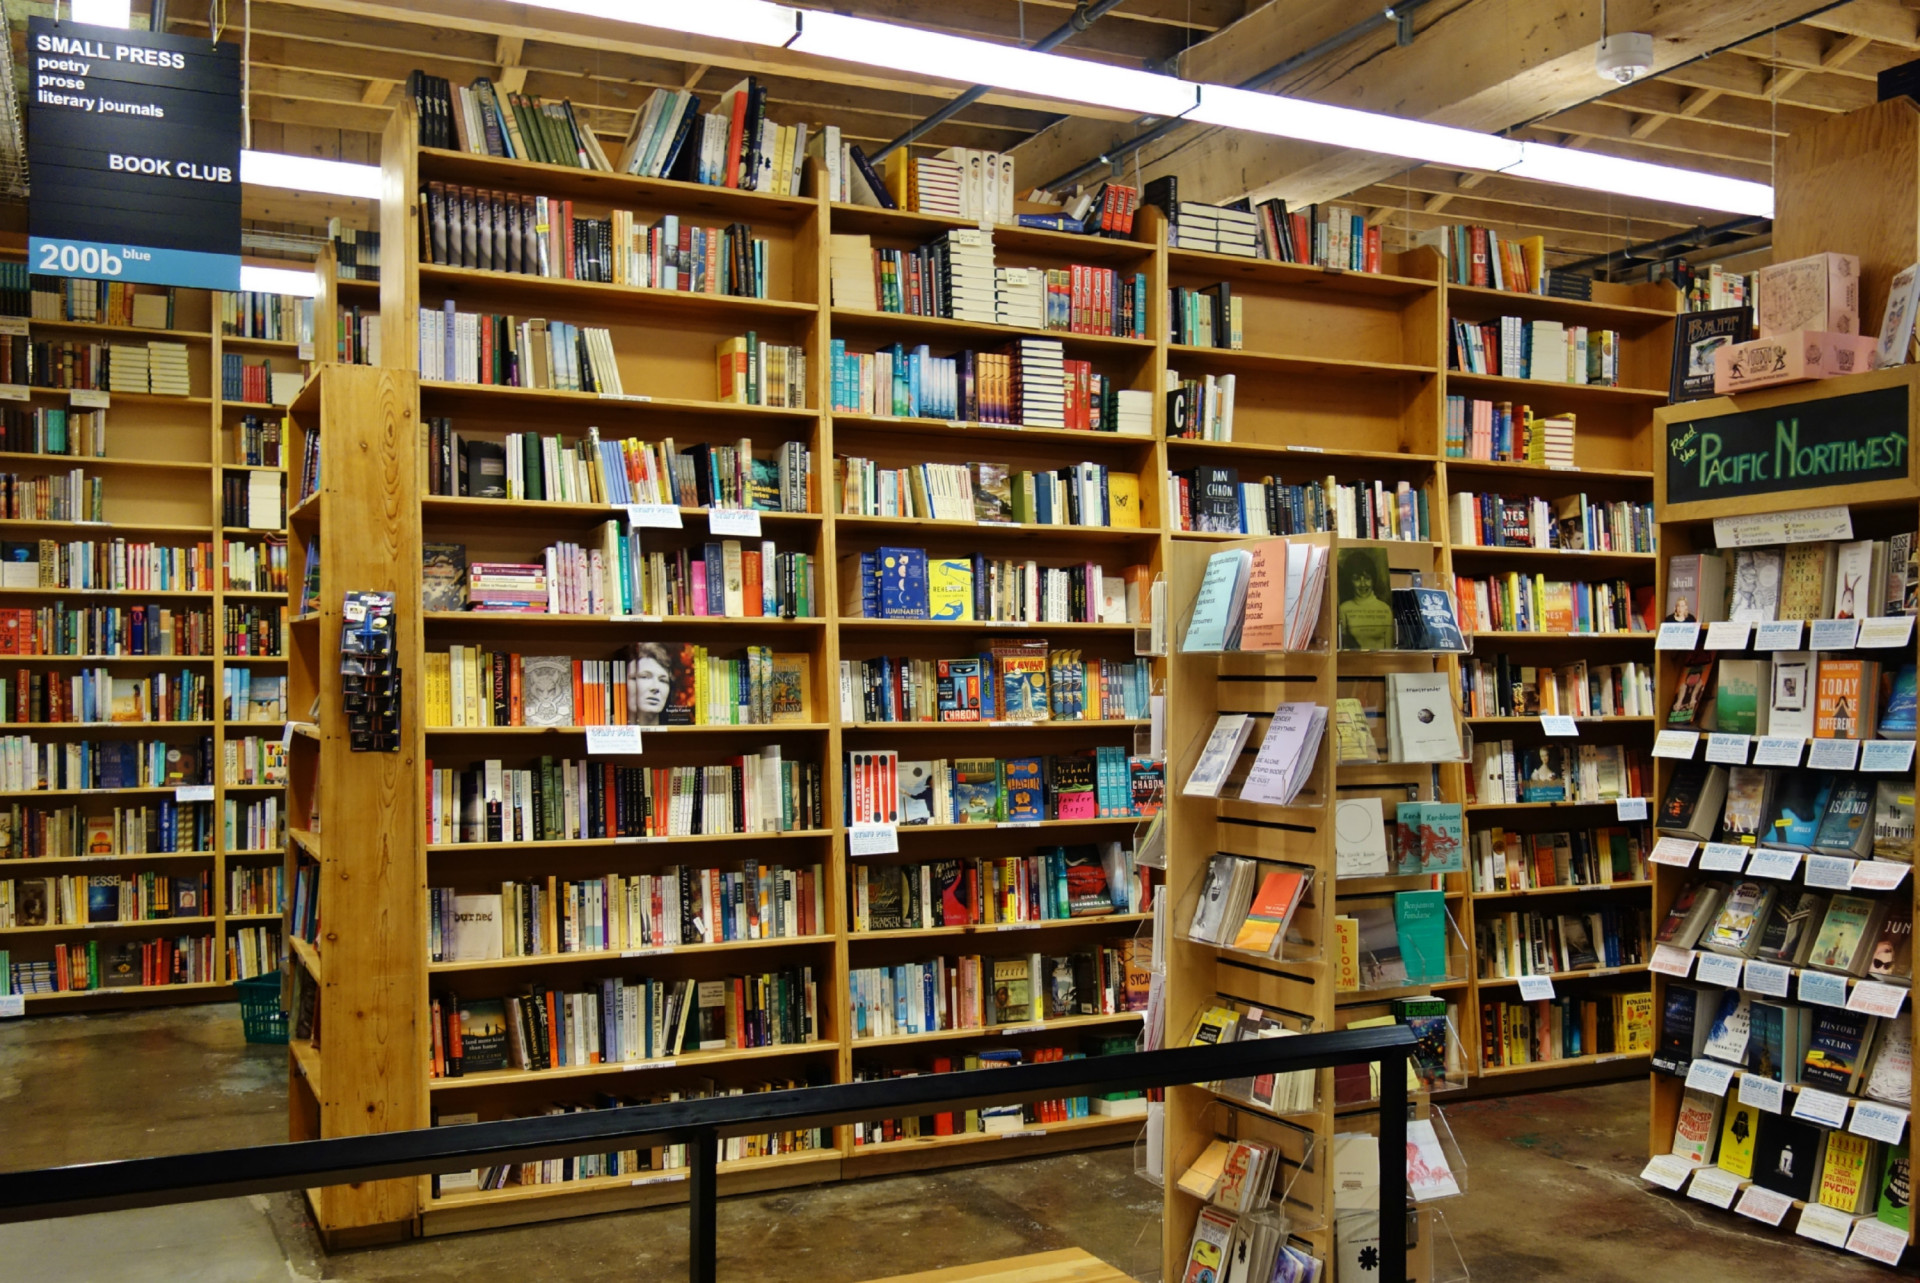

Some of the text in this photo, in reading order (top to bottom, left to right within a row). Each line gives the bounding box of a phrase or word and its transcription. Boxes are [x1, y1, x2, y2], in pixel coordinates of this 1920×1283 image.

[37, 35, 185, 69] SMALL PRESS
[38, 56, 90, 76] poetry
[38, 73, 85, 90] prose
[38, 90, 164, 118] literary journals
[109, 154, 232, 183] BOOK CLUB
[39, 244, 151, 275] 200b blue
[1173, 394, 1185, 429] C
[1670, 424, 1697, 456] Read
[1679, 447, 1698, 463] the
[1699, 418, 1908, 488] PACIFIC NORTHWEST
[1212, 470, 1228, 482] DAN
[1206, 483, 1233, 497] CHAON
[1213, 503, 1230, 515] ILL
[1892, 536, 1908, 548] ROSE
[1257, 570, 1266, 578] the
[1249, 580, 1270, 588] nternet
[1672, 576, 1693, 588] shrill
[1245, 612, 1264, 620] prozac
[1821, 679, 1858, 695] TODAY
[1820, 699, 1857, 711] WILL BE
[944, 710, 979, 720] CHABON
[1819, 718, 1857, 730] DIFFERENT
[1132, 780, 1164, 789] CHABON
[1062, 805, 1084, 814] Boys
[1829, 801, 1867, 814] ISLAND
[1889, 805, 1901, 819] The
[1426, 813, 1462, 822] Ker-bloom!
[1723, 813, 1759, 834] SKY
[1876, 822, 1915, 838] Underworld
[88, 876, 120, 887] HESSE
[1071, 899, 1111, 908] CHAMBERLAIN
[1404, 901, 1434, 912] Benjamin
[1831, 904, 1869, 915] CHICAGO
[454, 911, 493, 923] burned
[1130, 972, 1151, 986] SYCA
[1820, 1021, 1857, 1035] HISTORY
[1825, 1038, 1852, 1050] STARS
[1824, 1181, 1855, 1195] PYGMY
